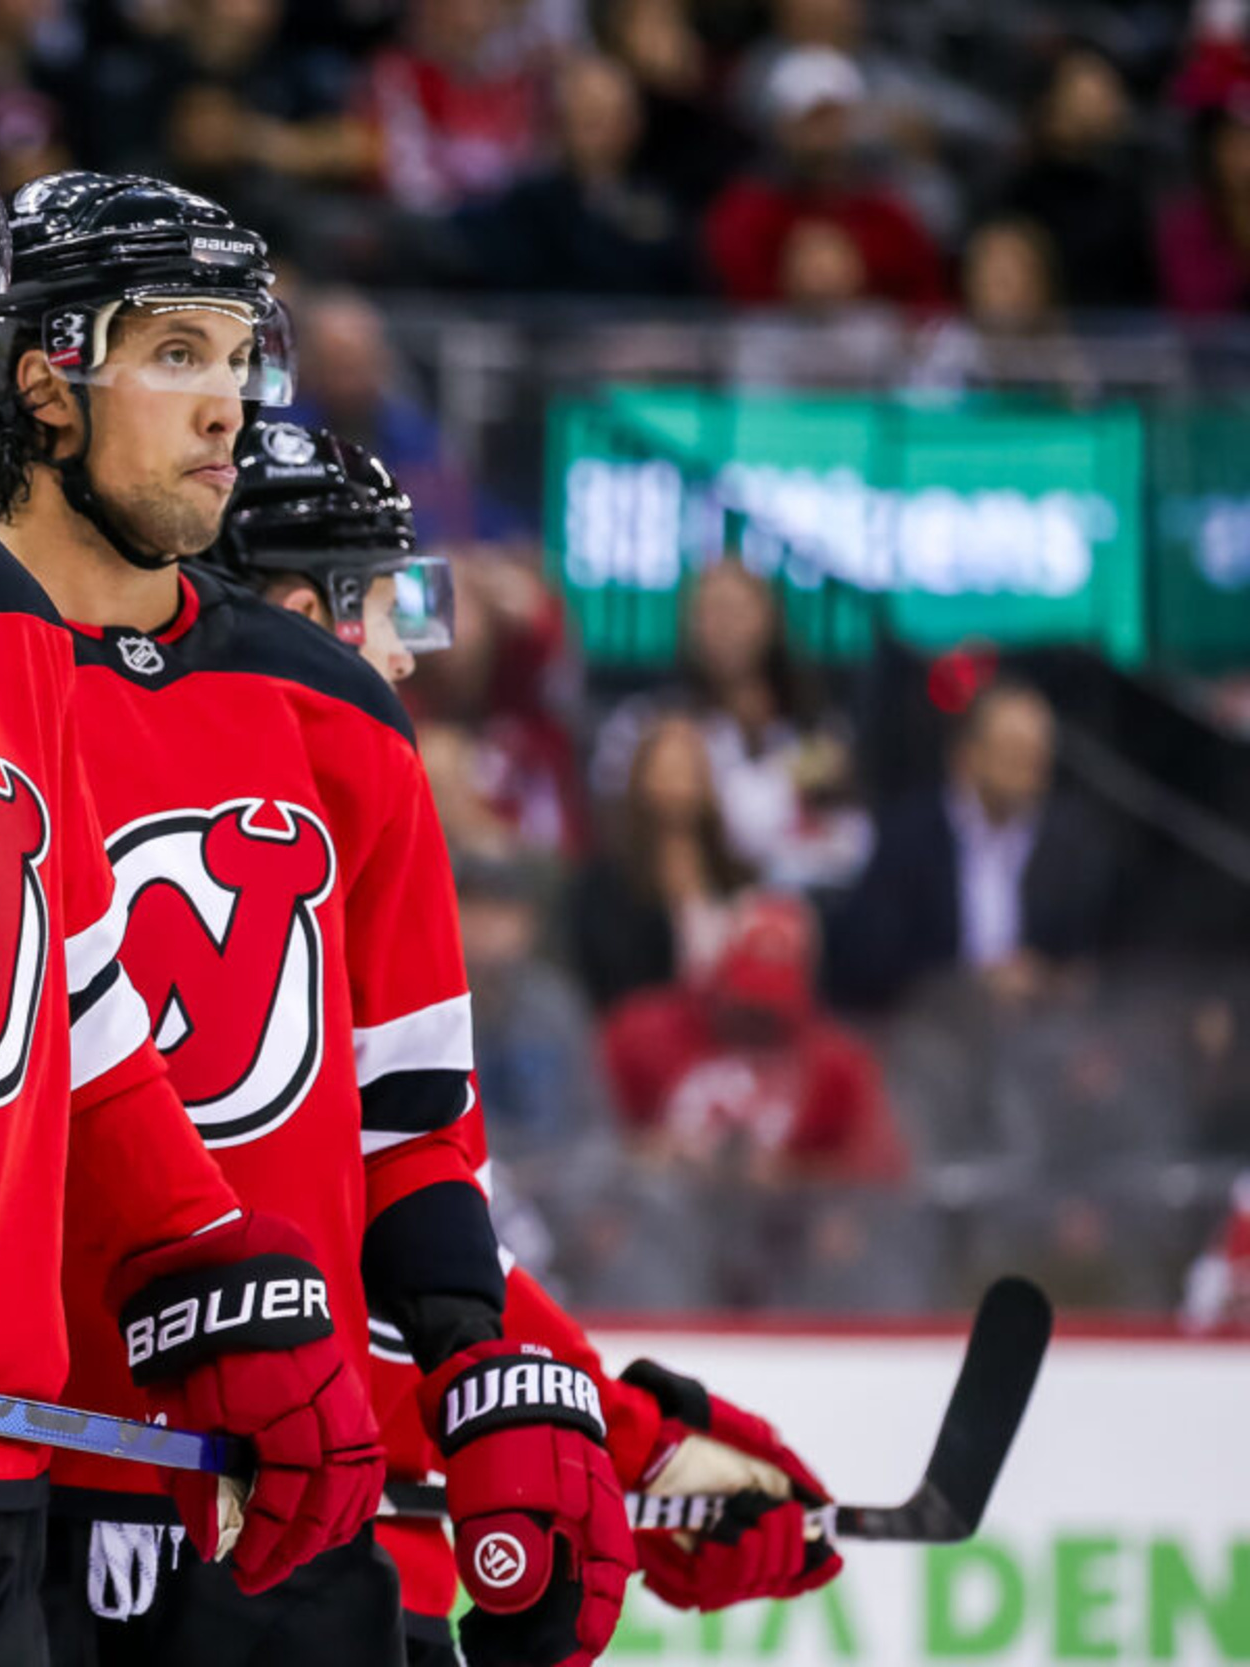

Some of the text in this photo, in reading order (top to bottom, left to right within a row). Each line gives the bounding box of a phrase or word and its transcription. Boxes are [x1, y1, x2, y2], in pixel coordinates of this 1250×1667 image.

[193, 237, 255, 255] BAUER
[126, 1278, 331, 1368] BAUER
[922, 1530, 1250, 1663] DEN
